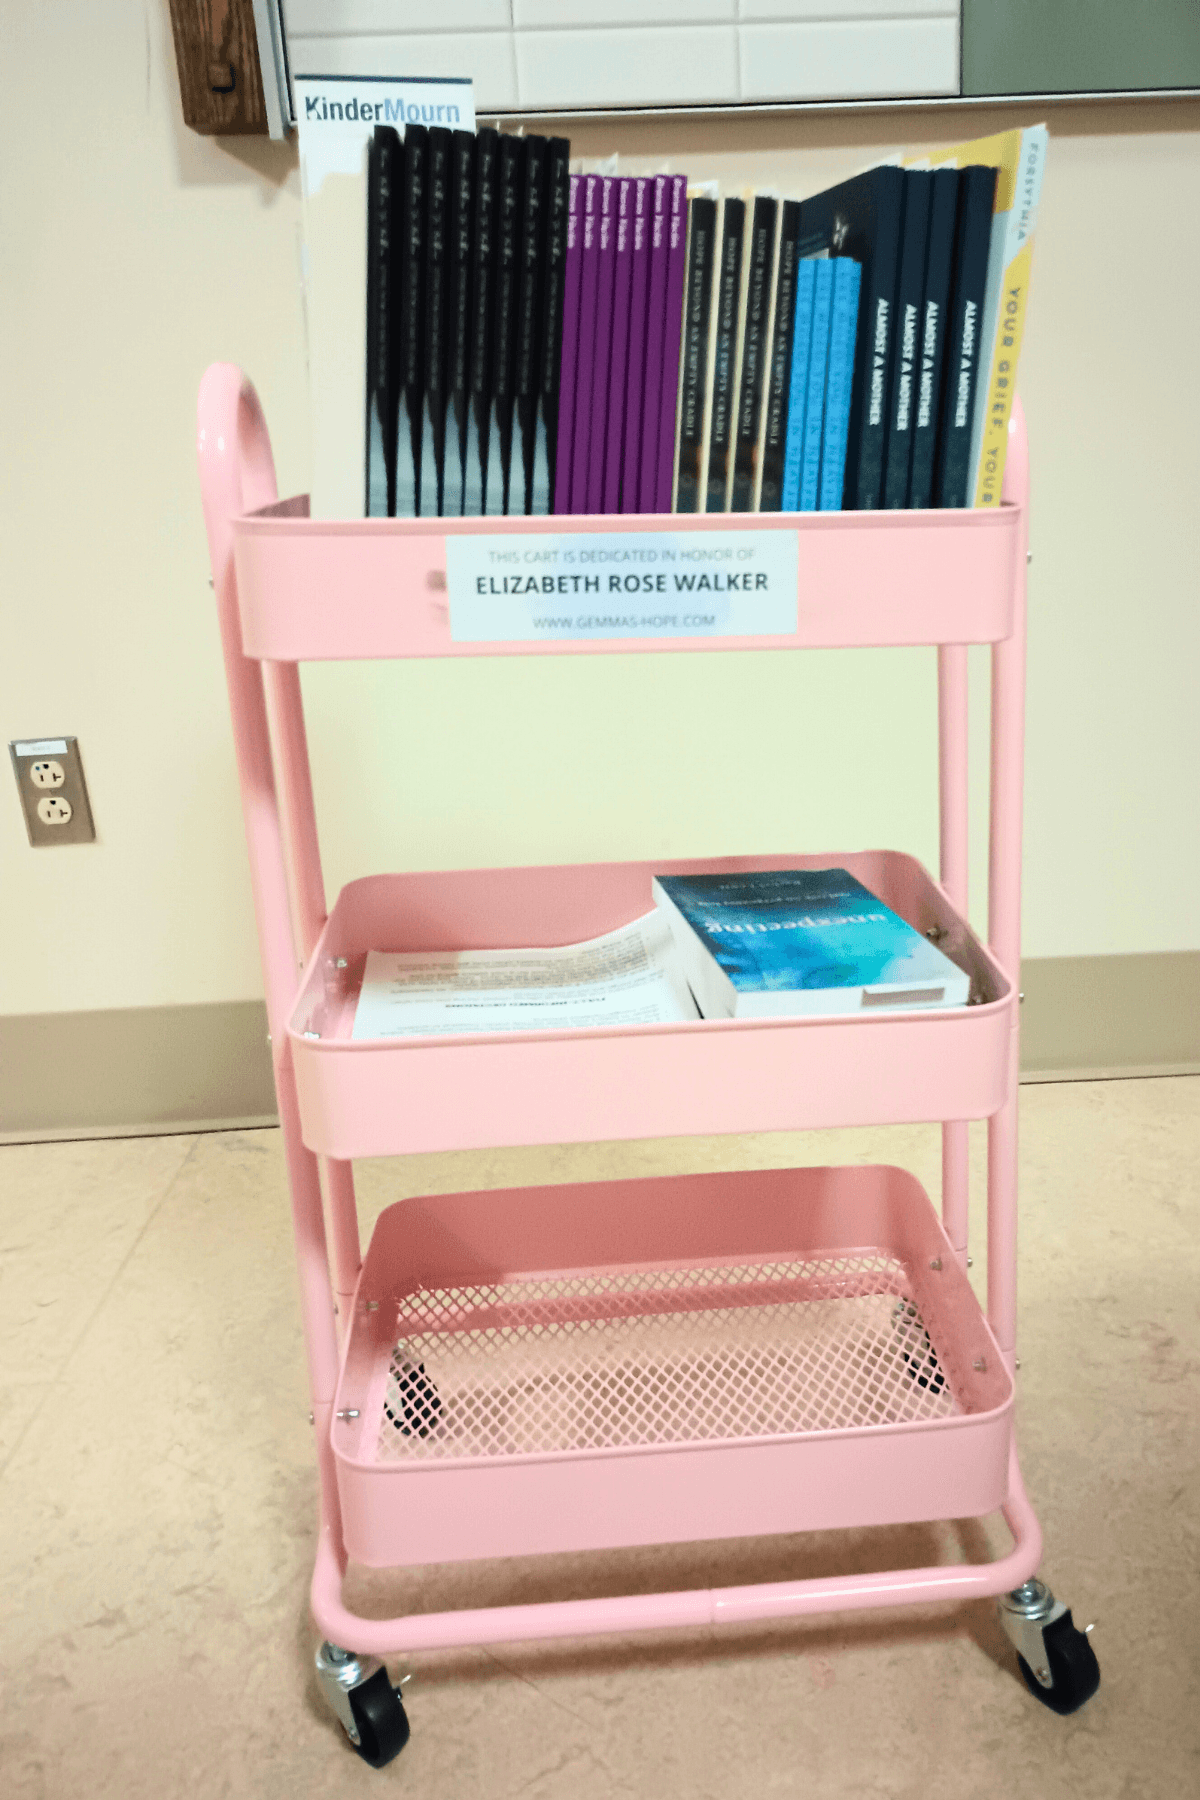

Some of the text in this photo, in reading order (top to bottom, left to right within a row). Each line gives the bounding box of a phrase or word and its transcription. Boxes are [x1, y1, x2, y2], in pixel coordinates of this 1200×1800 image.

[305, 96, 460, 124] KinderMourn
[1001, 287, 1020, 347] YOUR
[869, 297, 889, 426] ALMOST A MOTHER
[896, 303, 918, 431] ALMOST A MOTHER
[917, 300, 940, 428] ALMOST A MOTHER
[955, 300, 977, 428] ALMOST A MOTHER
[982, 446, 999, 503] YOUR
[476, 573, 769, 595] ELIZABETH ROSE WALKER
[489, 548, 756, 564] THIS CART IS DEDICATED IN HONOR OF
